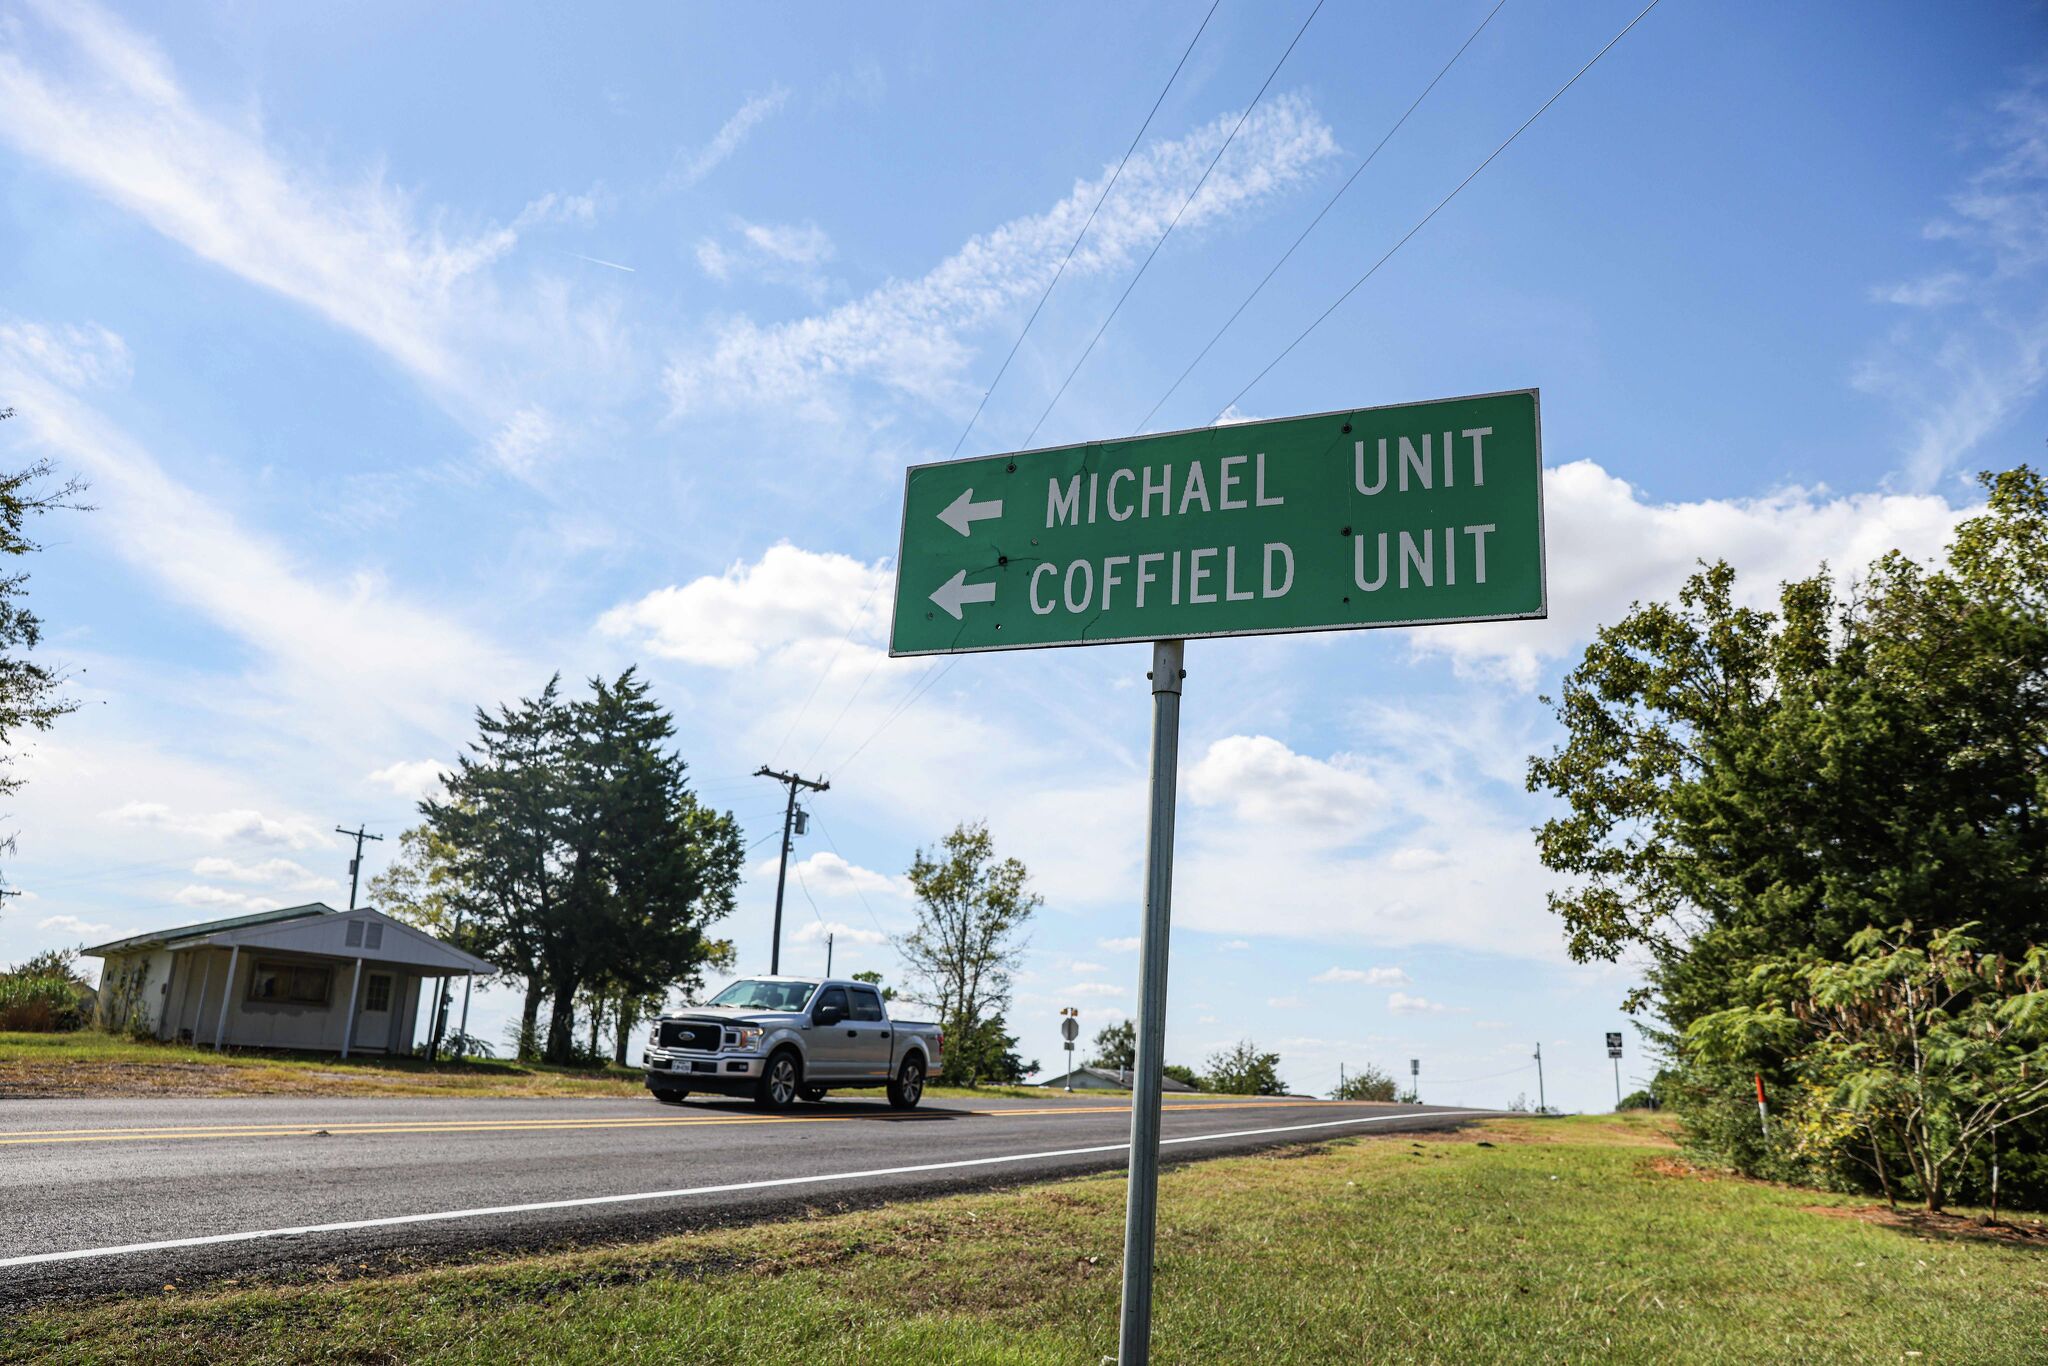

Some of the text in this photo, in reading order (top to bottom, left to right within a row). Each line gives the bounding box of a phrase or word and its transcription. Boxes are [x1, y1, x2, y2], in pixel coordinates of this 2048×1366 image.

[1046, 426, 1493, 528] MICHAEL UNIT
[1029, 523, 1496, 615] COFFIELD UNIT
